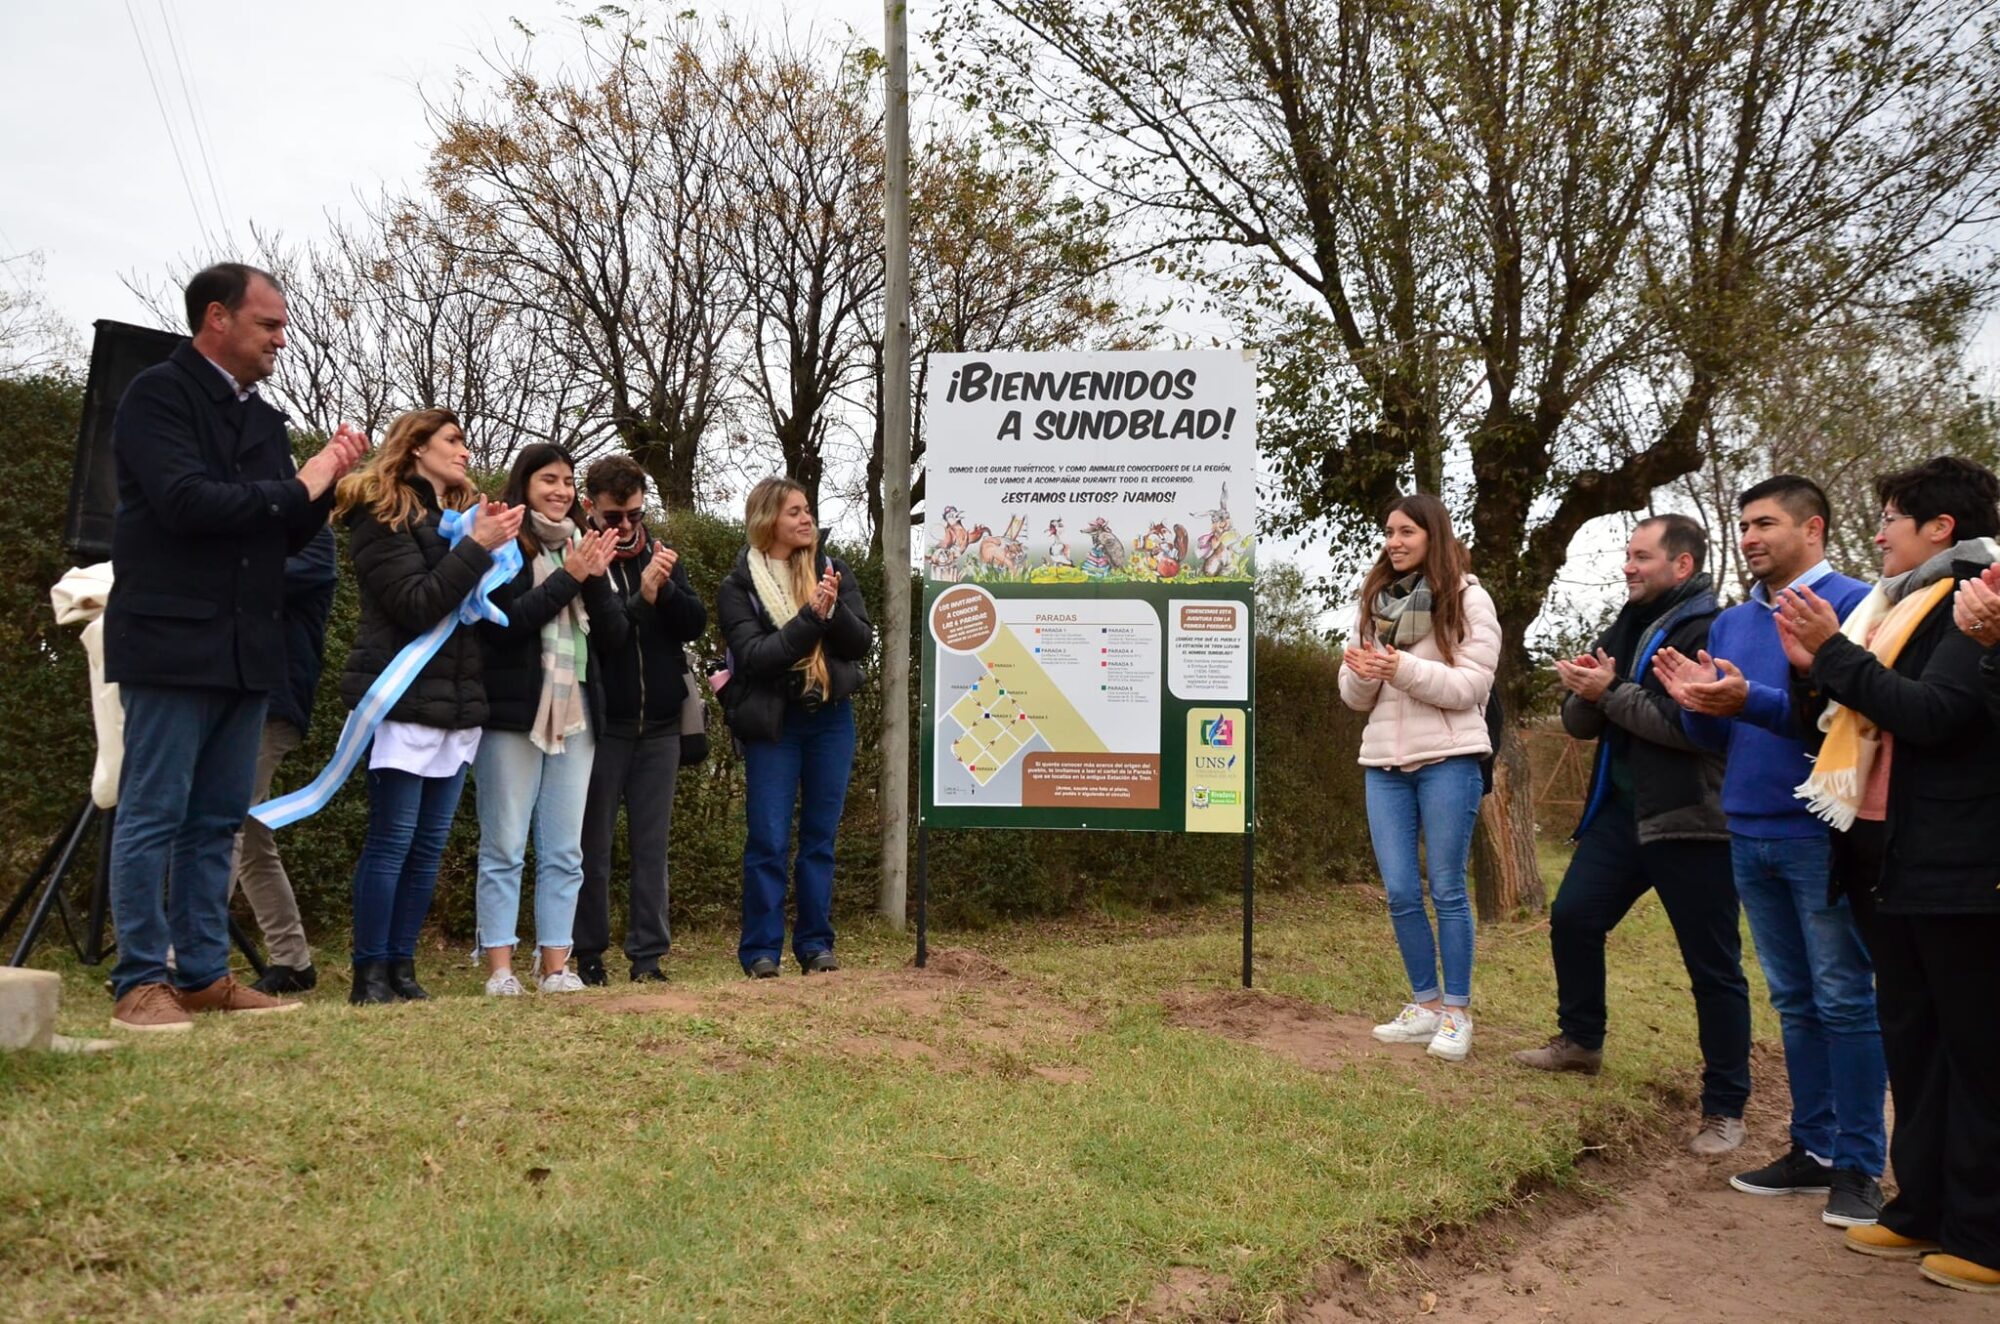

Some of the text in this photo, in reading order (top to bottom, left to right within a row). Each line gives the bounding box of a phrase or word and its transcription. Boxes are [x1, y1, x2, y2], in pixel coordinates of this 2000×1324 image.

[946, 361, 1197, 403] ¡BIENVENIDOS
[996, 406, 1237, 441] A SUNDBLAD!
[949, 466, 973, 474] SOMOS
[974, 466, 989, 474] LOS
[1013, 463, 1055, 474] TURÍSTICOS,
[1058, 465, 1064, 473] Y
[1065, 465, 1087, 473] COMO
[984, 476, 998, 484] LOS
[1026, 476, 1033, 484] A
[1034, 475, 1081, 484] ACOMPAÑAR
[1082, 476, 1117, 484] DURANTE
[1119, 476, 1139, 484] TODO
[1001, 491, 1177, 504] ¿ESTAMOS LISTOS? ¡VAMOS!
[1035, 614, 1078, 622] PARADAS
[1196, 757, 1225, 768] UNS
